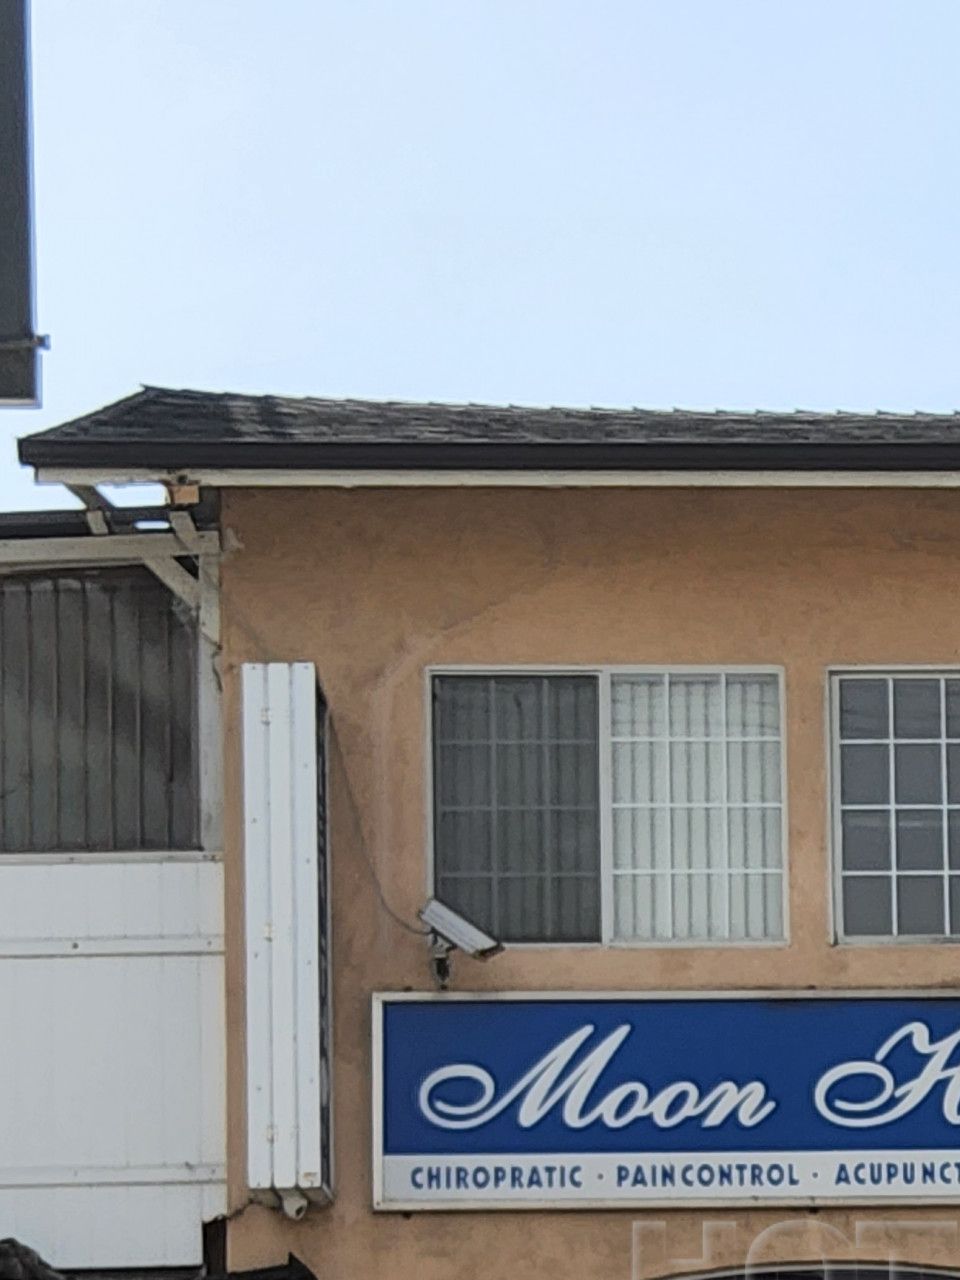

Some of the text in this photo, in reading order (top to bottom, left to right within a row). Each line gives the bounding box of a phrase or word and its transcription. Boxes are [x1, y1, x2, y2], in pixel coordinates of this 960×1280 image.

[419, 1024, 776, 1131] Moon
[410, 1163, 585, 1190] CHIROPRATIC
[617, 1161, 801, 1189] PAINCONTROL
